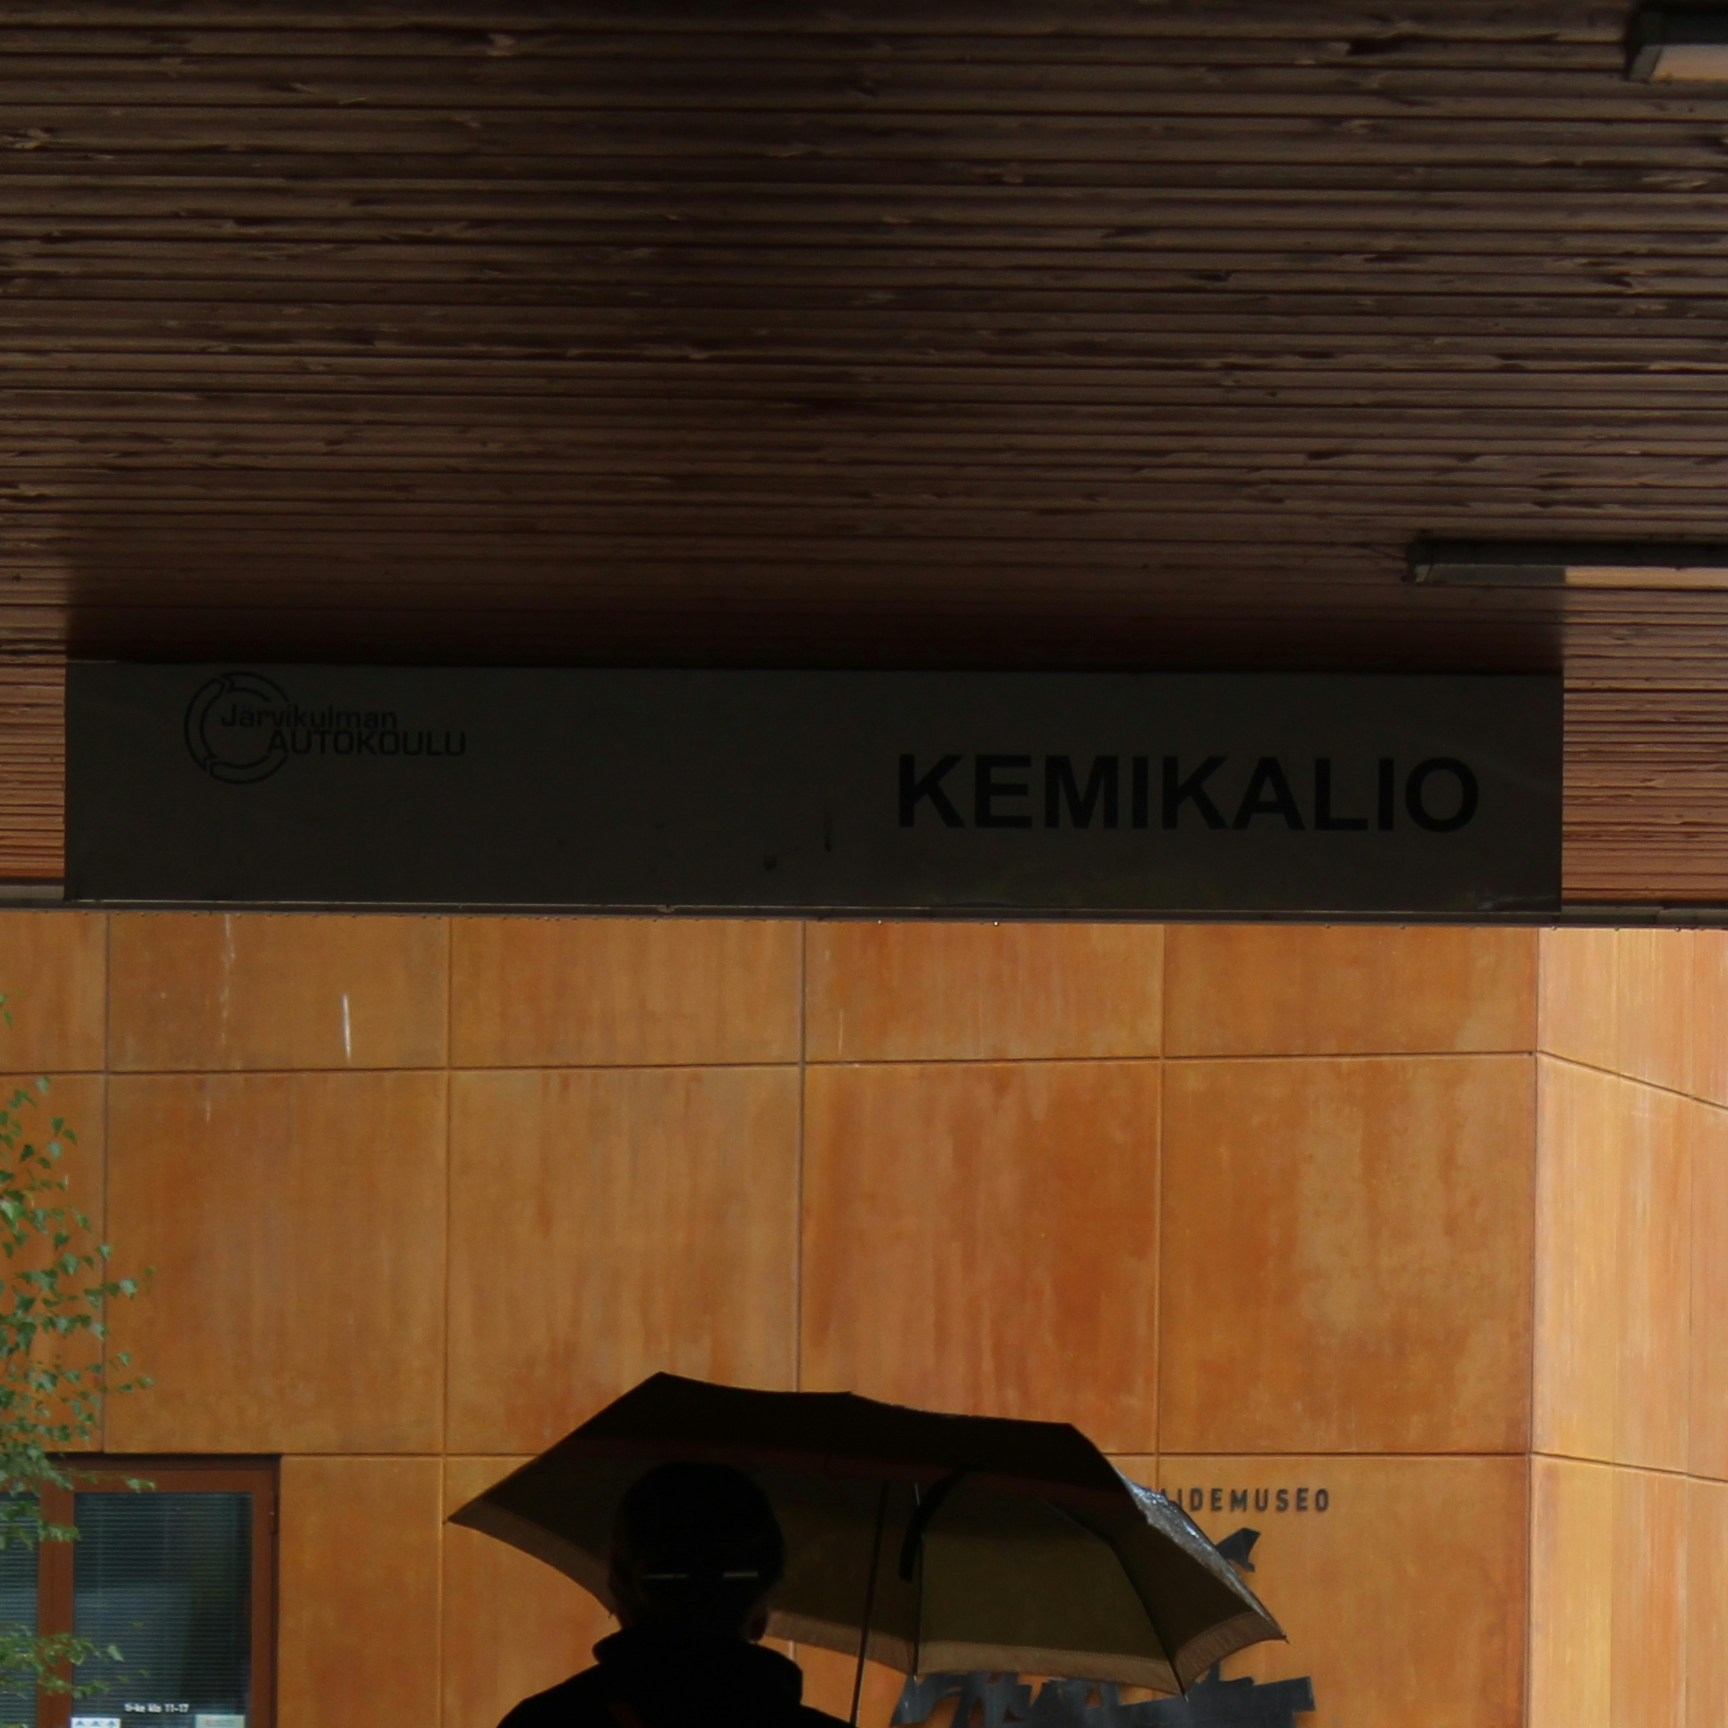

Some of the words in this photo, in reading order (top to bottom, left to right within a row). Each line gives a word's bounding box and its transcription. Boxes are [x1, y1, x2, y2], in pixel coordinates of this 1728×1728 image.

[221, 703, 398, 730] Järvikulman
[267, 729, 467, 756] AUTOKOULU
[896, 751, 1479, 833] KEMIKALIO
